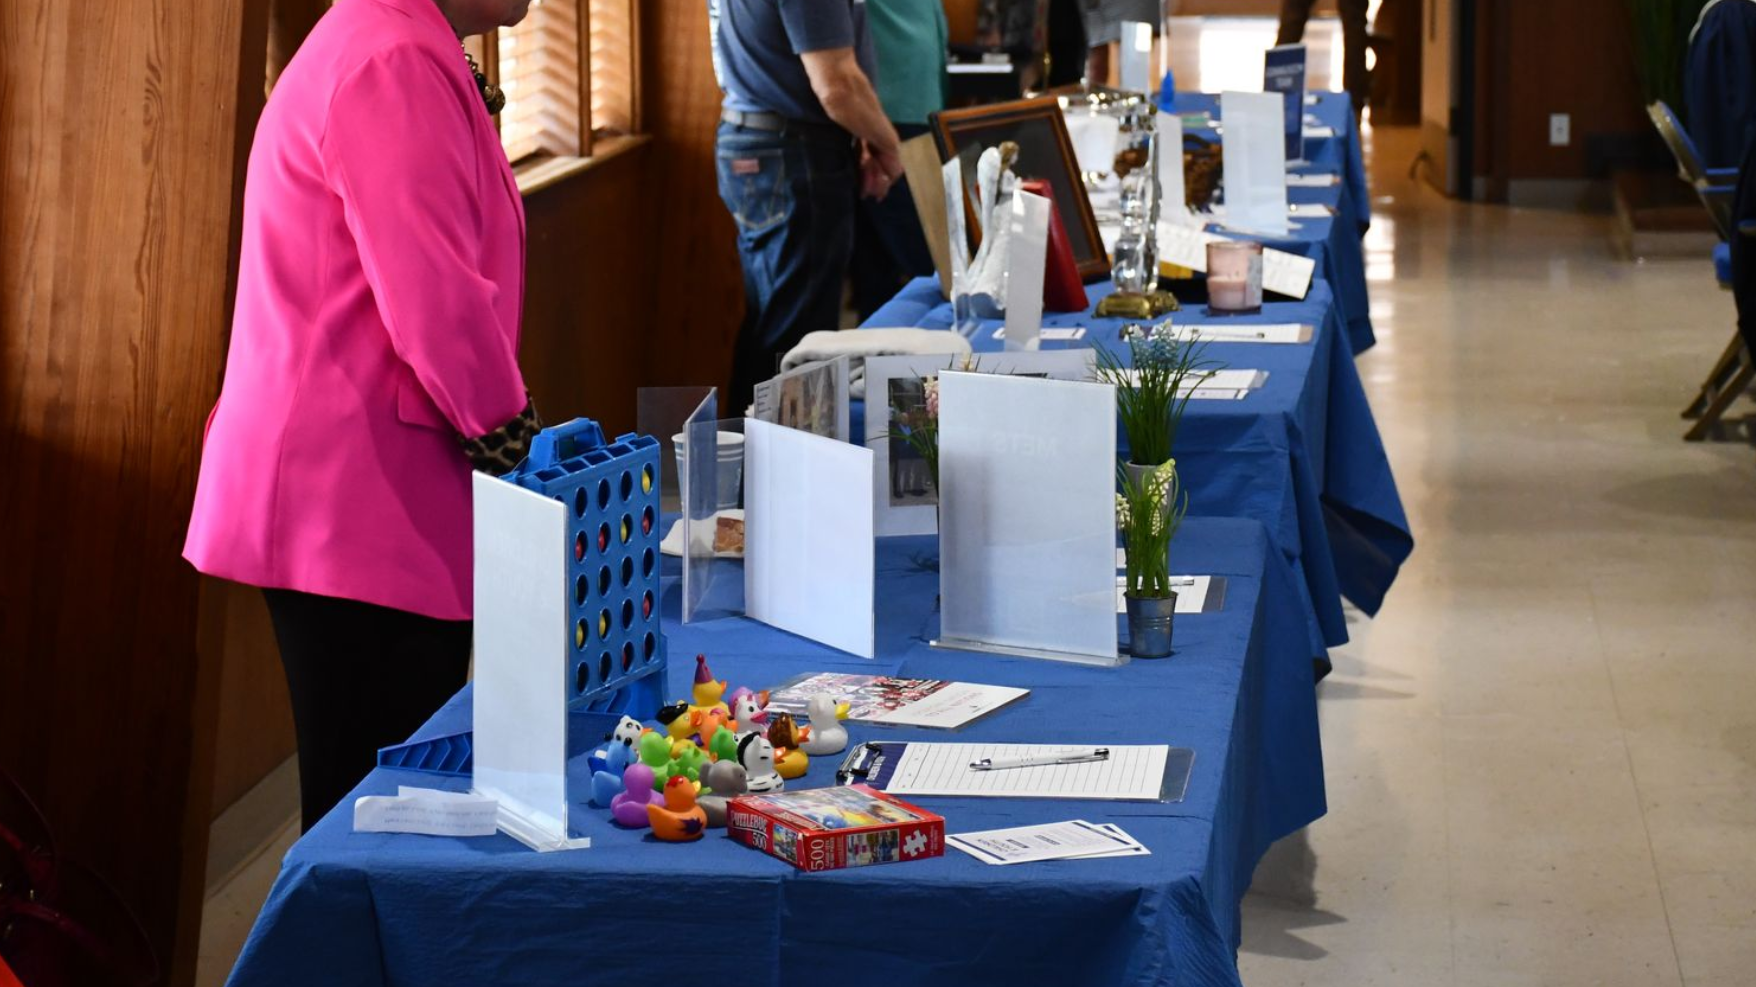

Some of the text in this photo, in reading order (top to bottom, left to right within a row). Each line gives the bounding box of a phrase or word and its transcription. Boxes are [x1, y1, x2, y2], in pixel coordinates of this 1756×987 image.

[731, 810, 768, 832] PUZZLEBUG
[752, 832, 767, 850] 500
[810, 839, 825, 871] 500
